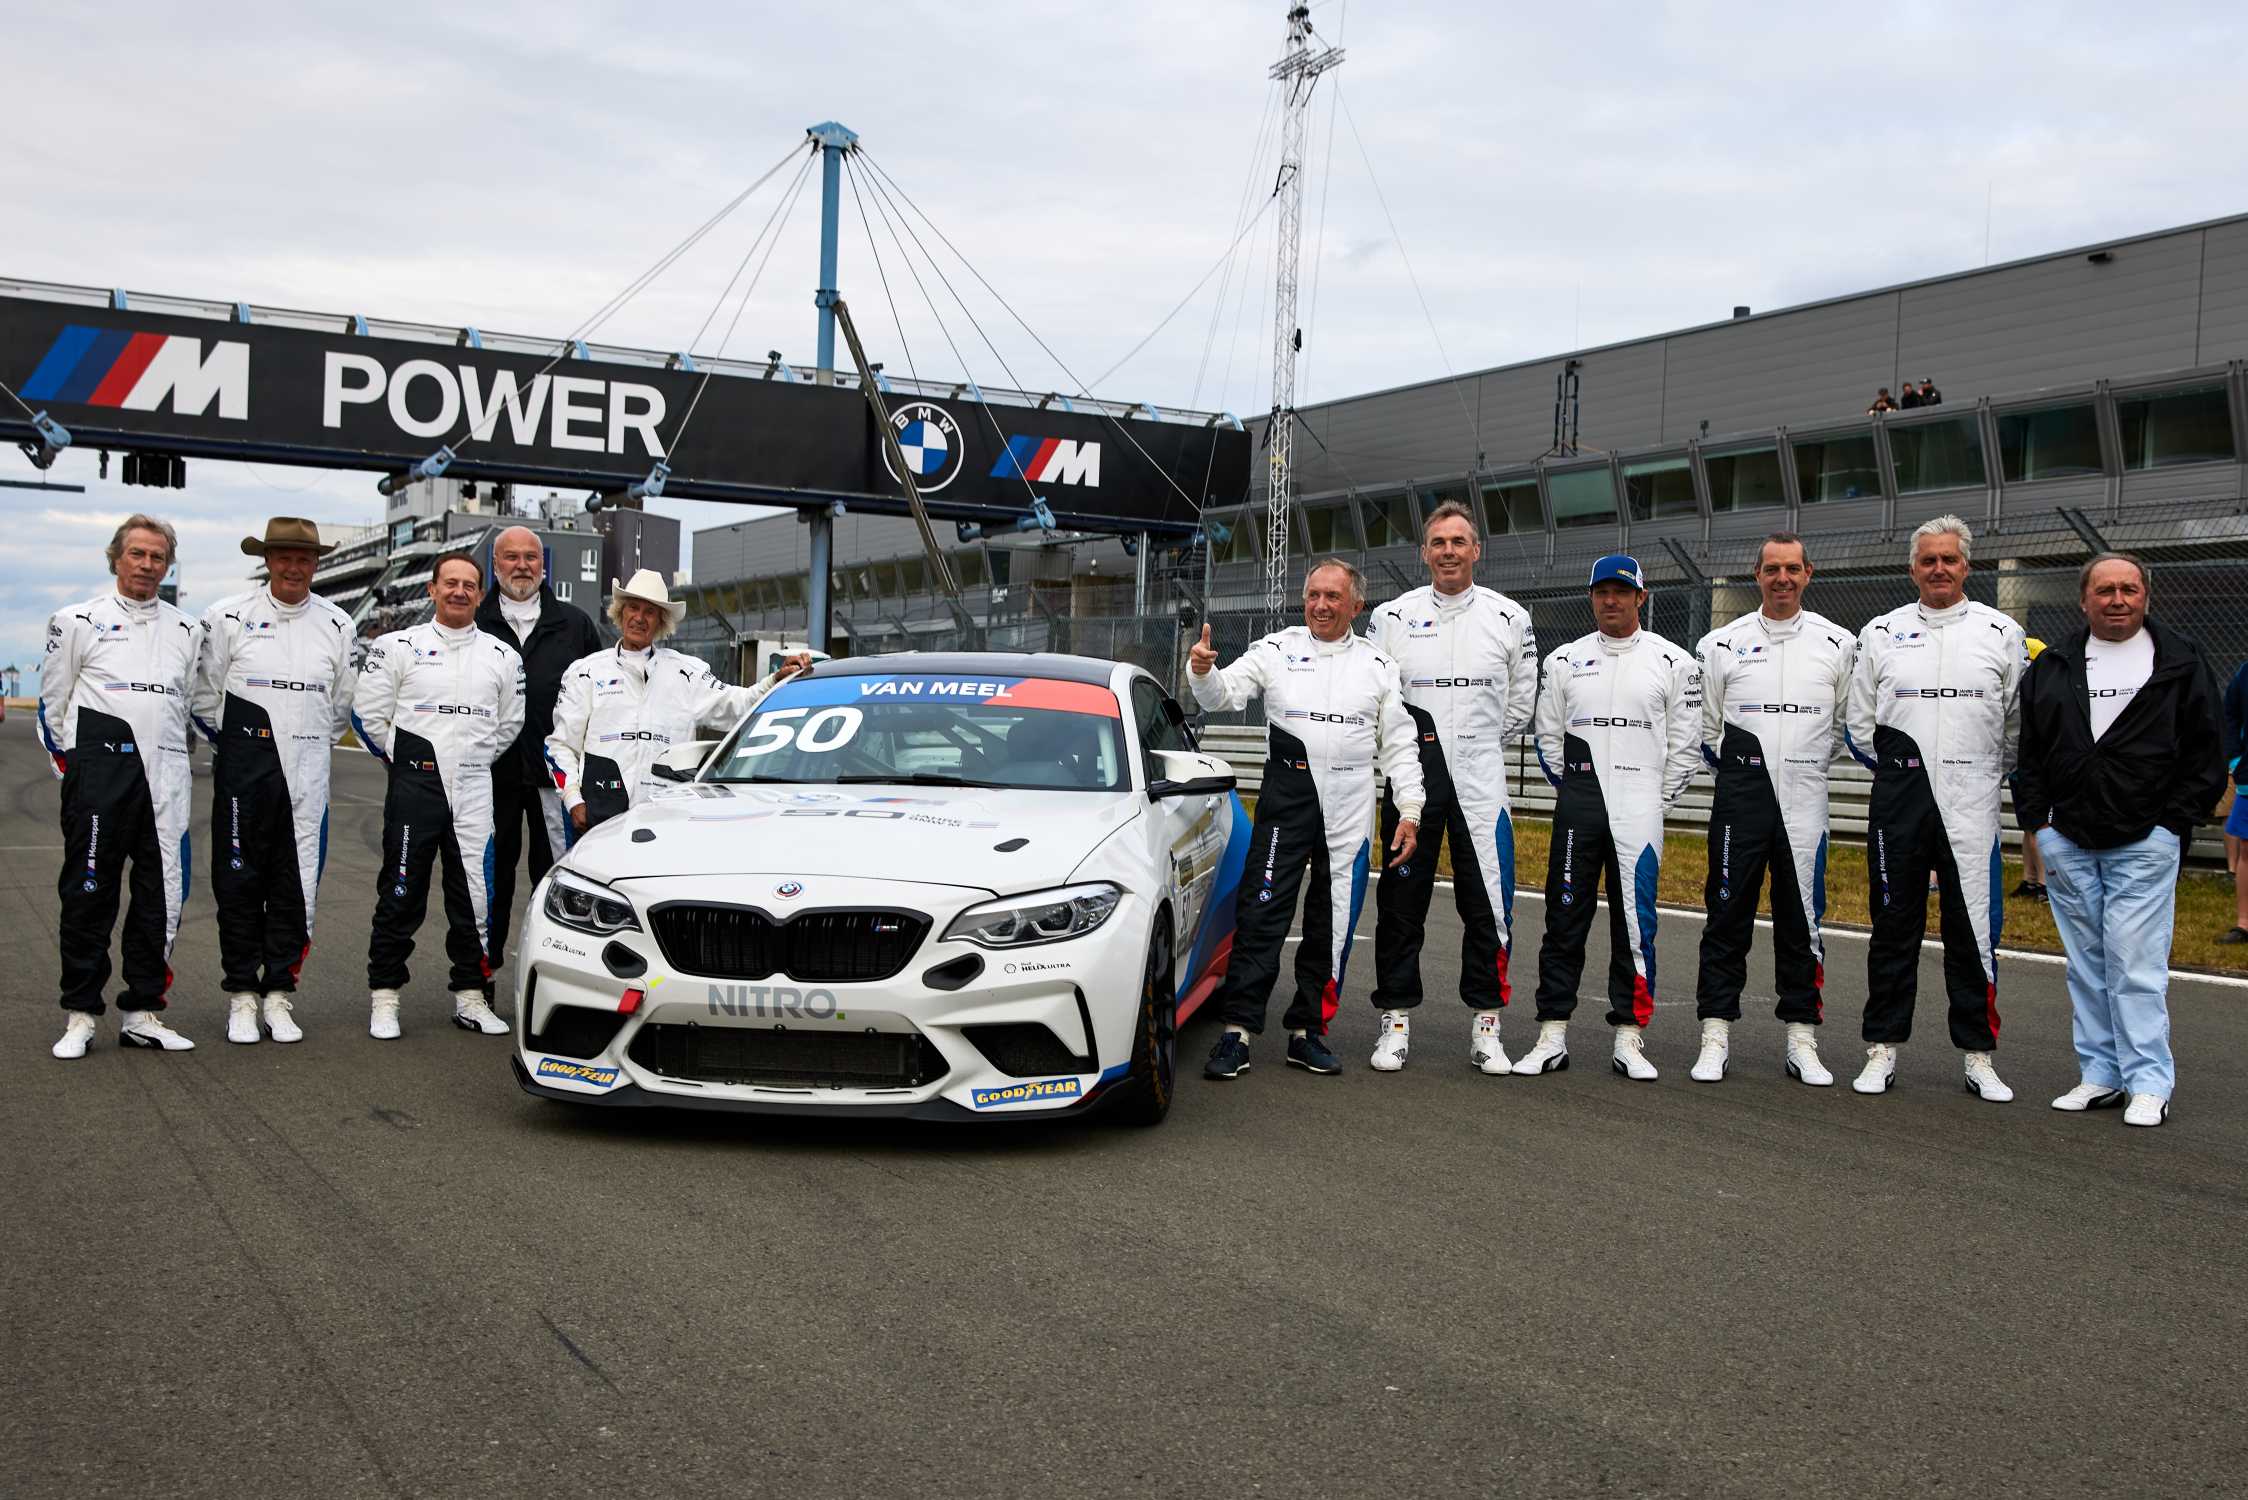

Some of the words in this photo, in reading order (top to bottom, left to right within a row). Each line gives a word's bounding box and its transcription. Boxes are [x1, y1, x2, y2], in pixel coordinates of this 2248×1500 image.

[121, 335, 250, 420] M
[323, 351, 667, 458] POWER
[895, 407, 954, 434] BMW
[1039, 438, 1100, 488] M
[131, 681, 165, 694] 50
[271, 679, 305, 691] 50
[860, 682, 924, 696] VAN
[929, 682, 1013, 698] MEEL
[1435, 677, 1469, 687] 50
[1920, 688, 1957, 698] 50
[438, 705, 471, 715] 50
[1310, 712, 1343, 724] 50
[1763, 704, 1798, 713] 50
[1593, 717, 1627, 727] 50
[621, 731, 652, 741] 50
[736, 706, 863, 758] 50
[779, 809, 906, 819] 50
[88, 814, 99, 857] Motorsport
[400, 824, 410, 864] Motorsport
[1267, 826, 1280, 868] Motorsport
[1565, 828, 1574, 871] Motorsport
[1723, 825, 1731, 866] Motorsport
[1878, 829, 1886, 871] Motorsport
[1021, 964, 1046, 972] HELIX
[540, 1061, 615, 1083] GOODYEAR
[976, 1081, 1077, 1104] GOODYEAR
